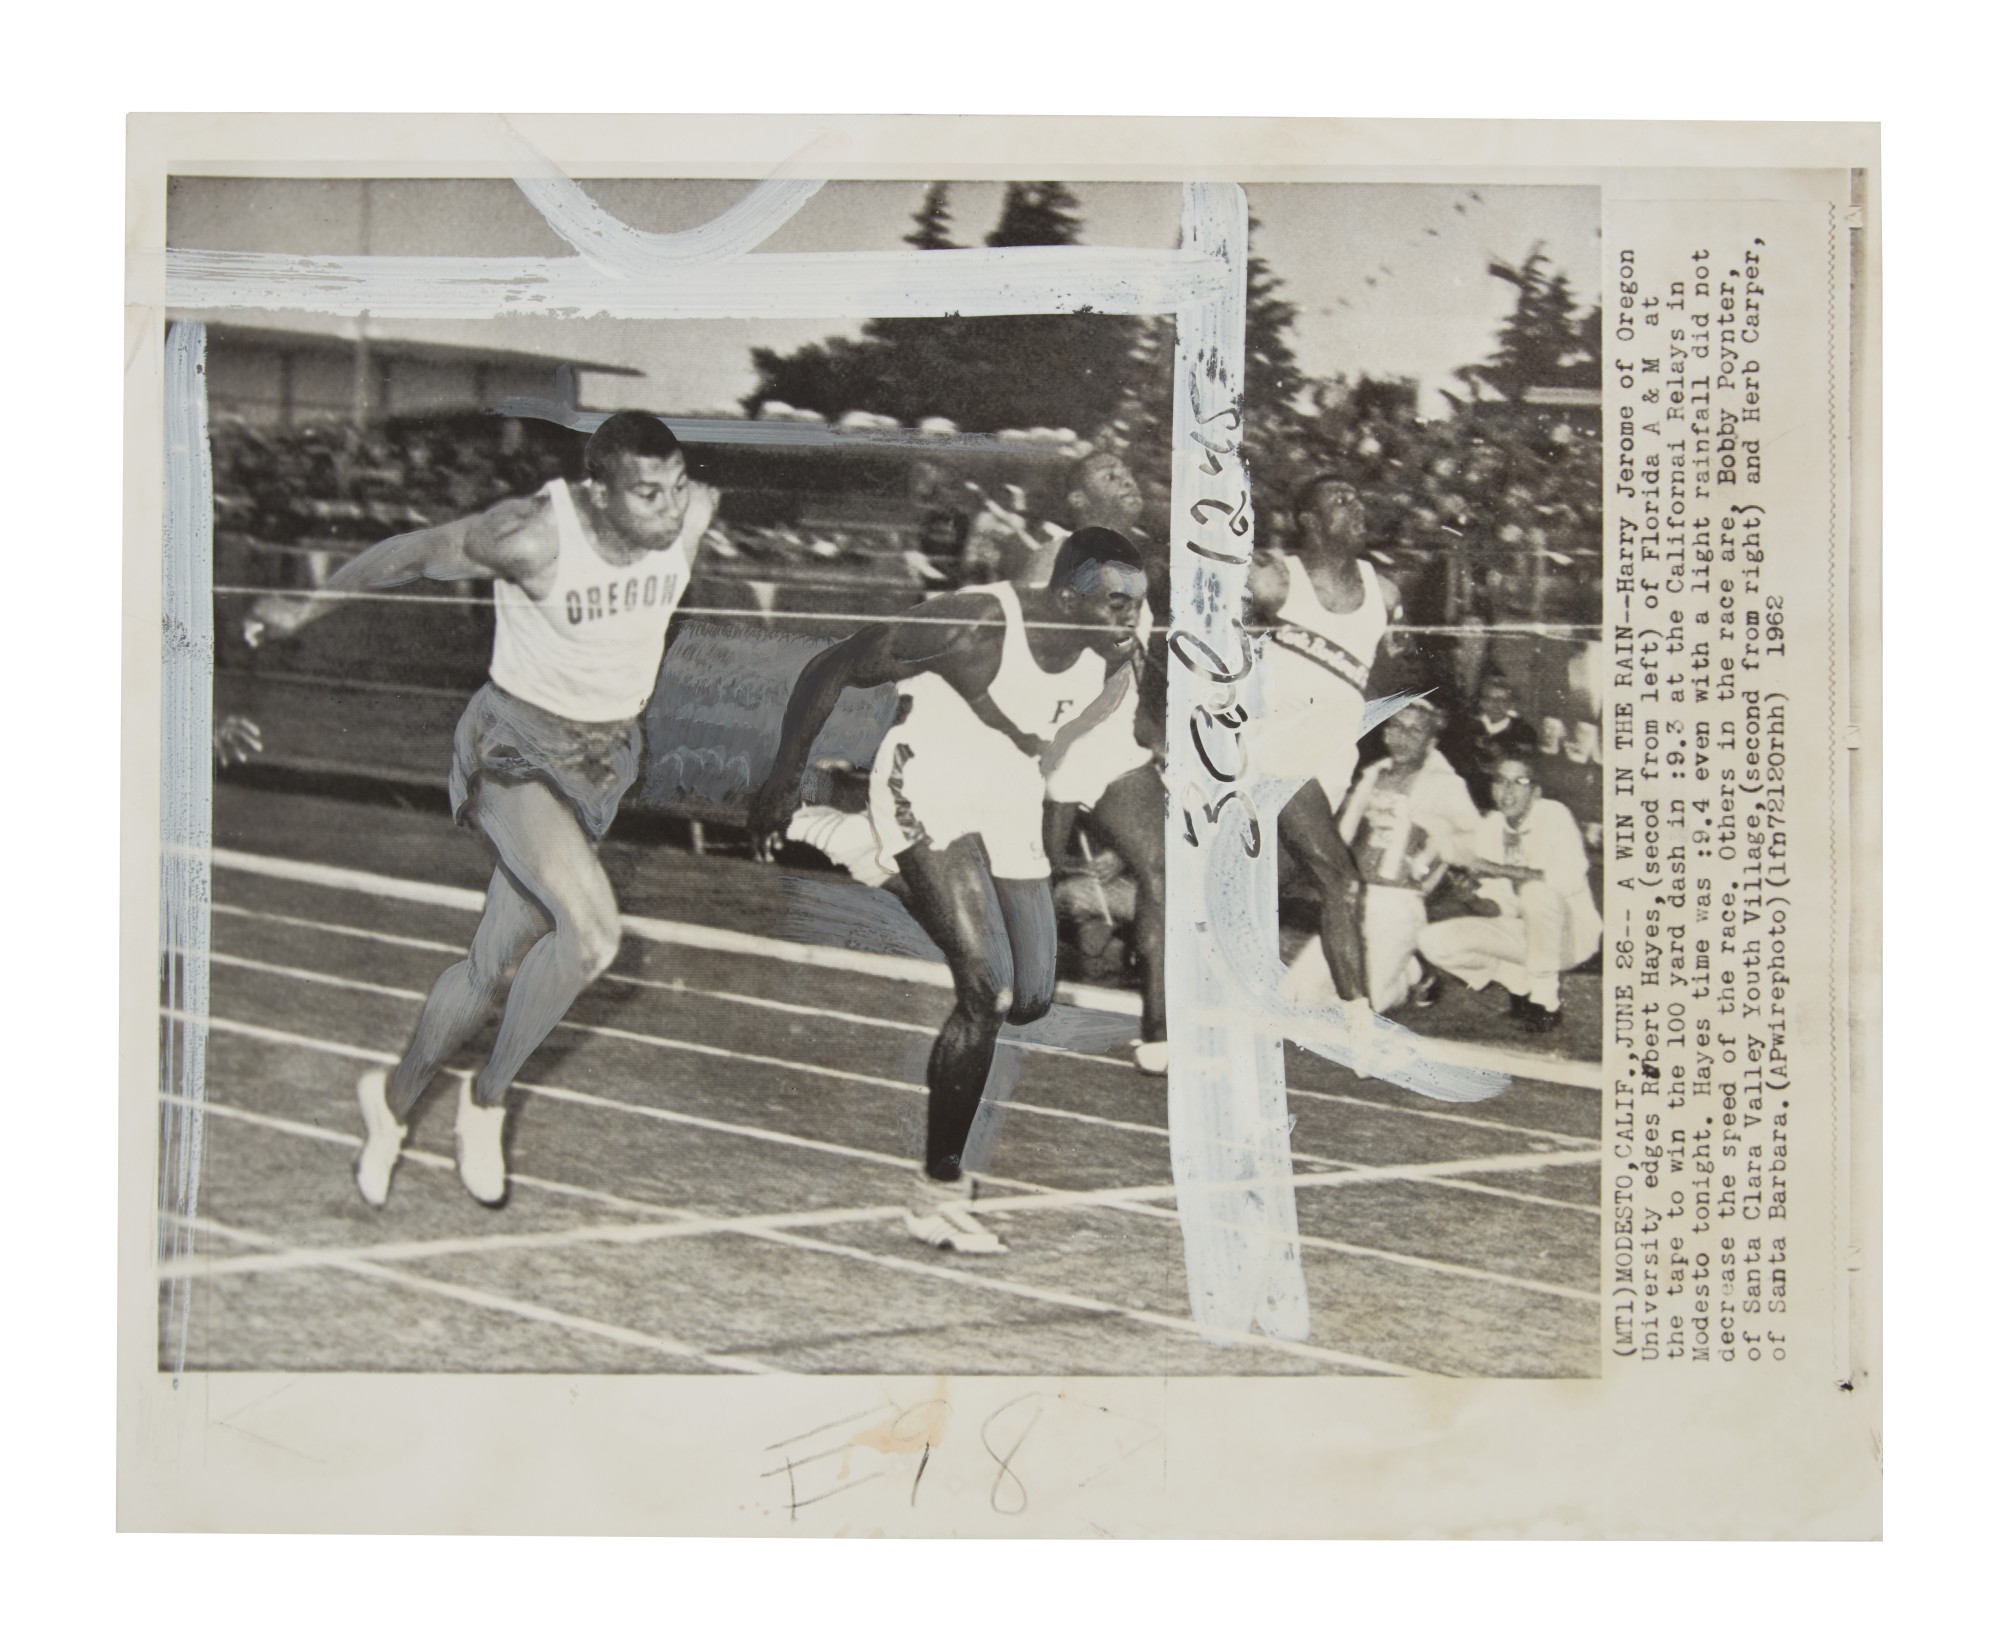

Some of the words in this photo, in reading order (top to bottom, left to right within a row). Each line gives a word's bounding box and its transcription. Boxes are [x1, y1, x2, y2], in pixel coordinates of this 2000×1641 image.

[1615, 249, 1639, 342] Oregon
[1665, 281, 1685, 311] in
[1690, 248, 1710, 297] not
[1740, 237, 1766, 344] Carper,
[1641, 296, 1660, 327] at
[1690, 312, 1710, 359] did
[1716, 269, 1741, 390] Poynter,
[1614, 358, 1635, 390] of
[1641, 357, 1661, 374] M
[1665, 328, 1689, 421] Relays
[1740, 359, 1761, 423] Herb
[1641, 388, 1660, 405] &
[1615, 405, 1636, 499] Jerome
[1641, 421, 1661, 437] A
[1690, 375, 1711, 499] rainfall
[1715, 407, 1740, 486] Bobby
[1741, 439, 1761, 485] and
[1640, 453, 1661, 562] Florida
[1665, 439, 1686, 594] Californai
[1720, 504, 1740, 563] are,
[1690, 516, 1715, 594] light
[1738, 504, 1767, 594] right)
[565, 574, 677, 625] OREGON
[1639, 577, 1660, 610] of
[1694, 610, 1710, 625] a
[1719, 578, 1735, 641] race
[1665, 609, 1685, 655] the
[1740, 610, 1760, 671] from
[1765, 595, 1786, 657] 1962
[1637, 628, 1664, 703] left)
[1665, 673, 1685, 704] at
[1690, 641, 1710, 704] with
[1715, 657, 1736, 702] the
[1049, 699, 1073, 724] F
[1614, 702, 1634, 751] THE
[1716, 721, 1736, 751] in
[1639, 719, 1660, 781] from
[1665, 719, 1688, 779] :9.3
[1694, 720, 1711, 782] even
[1614, 766, 1635, 797] IN
[1615, 813, 1635, 861] WIN
[1666, 799, 1686, 829] in
[1691, 798, 1713, 858] :9.4
[1716, 768, 1737, 861] Others
[1616, 877, 1635, 891] A
[1666, 845, 1686, 909] dash
[1696, 878, 1712, 923] was
[1720, 881, 1740, 954] race.
[1666, 924, 1689, 987] yard
[1690, 938, 1711, 1000] time
[1742, 939, 1761, 1019] Youth
[1716, 970, 1736, 1016] the
[1640, 1002, 1662, 1097] Rbert
[1666, 1002, 1686, 1048] 100
[1717, 1032, 1737, 1064] of
[1667, 1064, 1686, 1110] the
[1692, 1018, 1715, 1097] Hayes
[1743, 1033, 1767, 1129] Valley
[1717, 1081, 1742, 1158] speed
[1640, 1113, 1664, 1189] edges
[1666, 1129, 1686, 1174] win
[1691, 1116, 1715, 1235] tonight.
[1666, 1190, 1685, 1219] to
[1717, 1174, 1737, 1219] the
[1742, 1144, 1763, 1221] Clara
[1640, 1207, 1663, 1361] University
[1666, 1237, 1690, 1297] tape
[1742, 1237, 1762, 1314] Santa
[1767, 1236, 1787, 1313] Santa
[1690, 1252, 1711, 1362] Modesto
[1717, 1237, 1737, 1363] decrease
[1666, 1315, 1685, 1360] the
[1742, 1330, 1762, 1362] of
[1767, 1330, 1786, 1362] of
